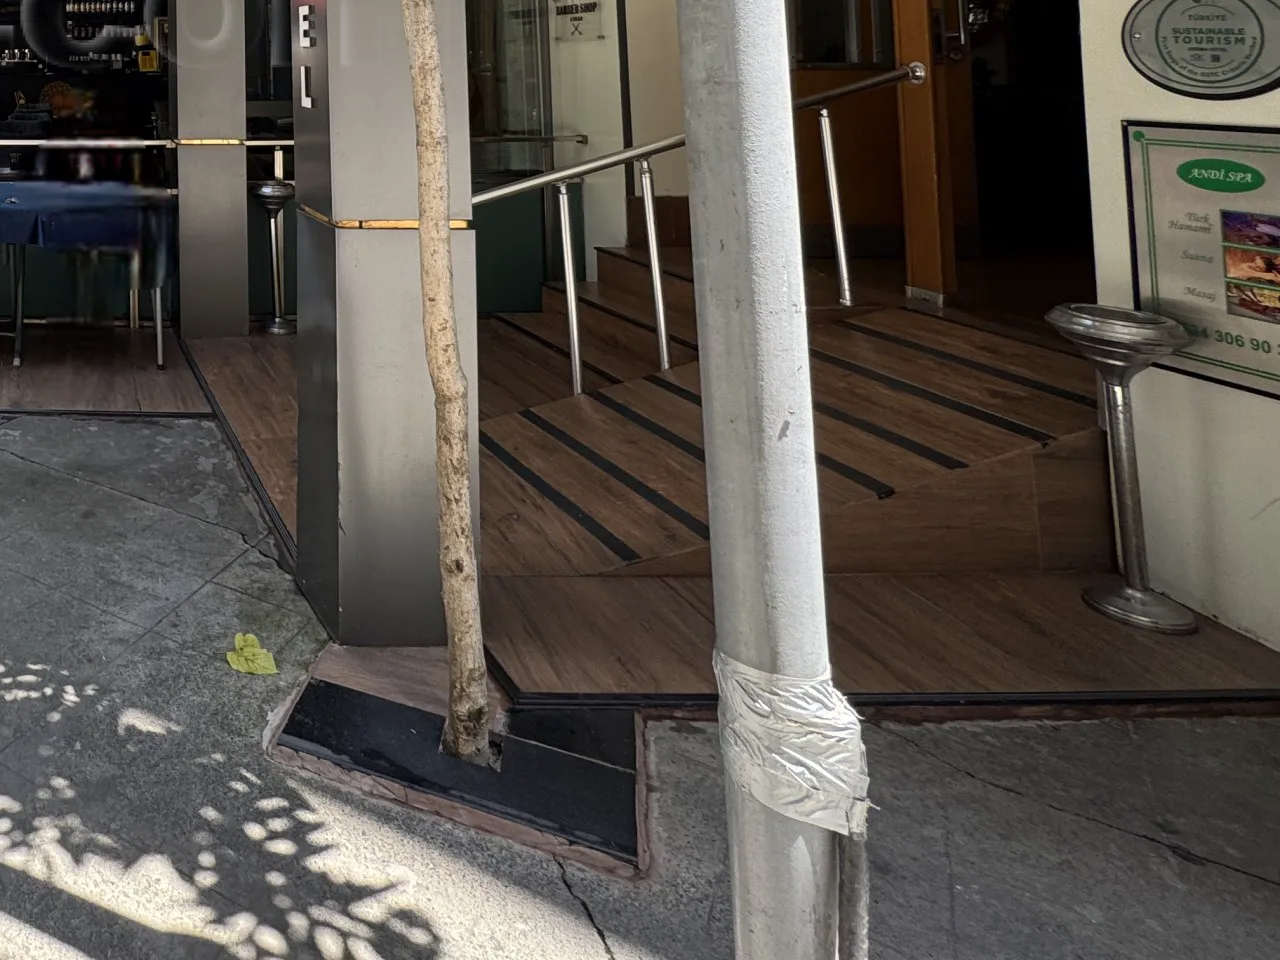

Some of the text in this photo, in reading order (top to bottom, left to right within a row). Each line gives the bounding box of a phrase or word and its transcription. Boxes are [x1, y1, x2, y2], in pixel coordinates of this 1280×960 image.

[580, 2, 597, 13] SHOP
[1171, 27, 1246, 35] SUSTAINABLE
[1173, 36, 1246, 46] TOURISM
[1189, 169, 1253, 184] ANDİ SPA
[1215, 330, 1244, 347] 306
[1251, 338, 1272, 353] 90
